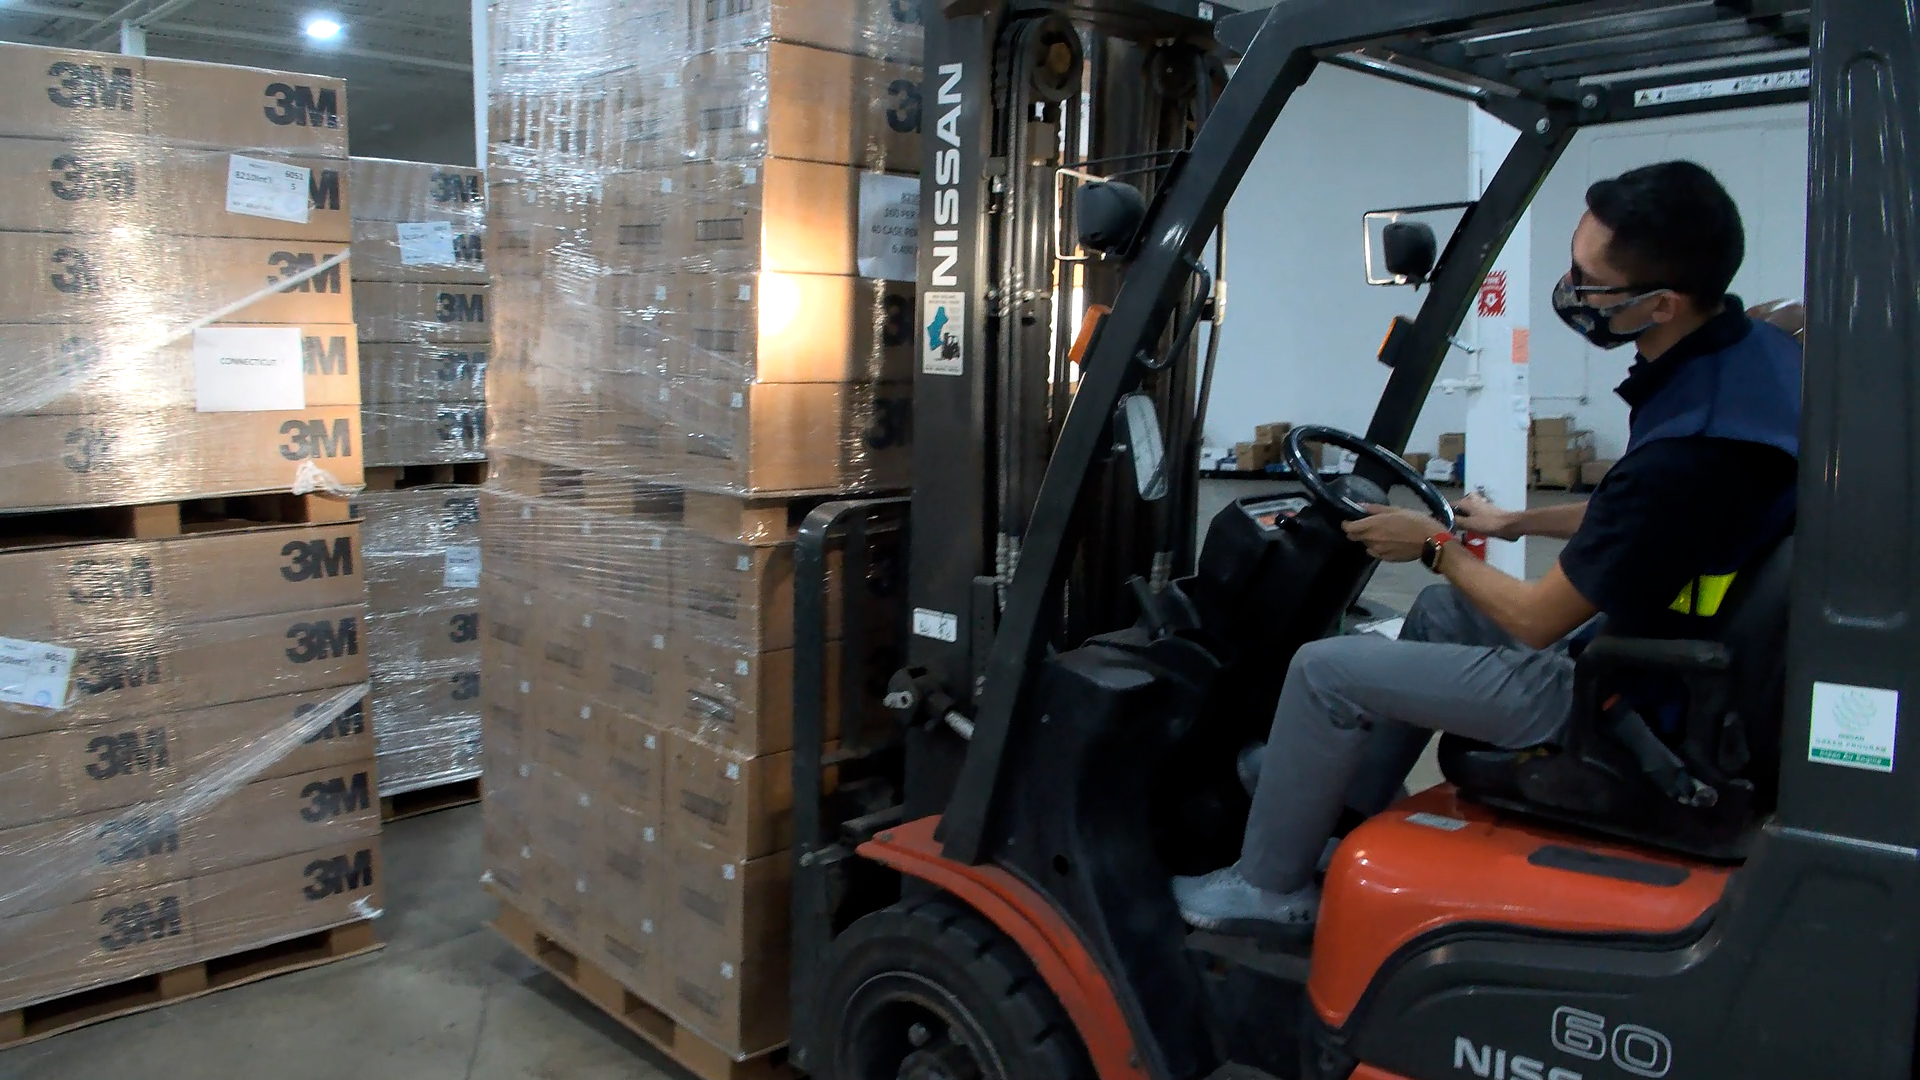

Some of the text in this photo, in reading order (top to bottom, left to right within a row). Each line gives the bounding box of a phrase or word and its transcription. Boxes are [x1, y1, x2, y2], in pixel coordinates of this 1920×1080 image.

[48, 62, 133, 111] 3M
[264, 83, 337, 128] 3M
[886, 79, 922, 133] 3
[308, 168, 340, 210] M
[430, 172, 478, 202] 3M
[932, 62, 963, 287] NISSAN
[267, 251, 341, 294] 3M
[435, 292, 485, 323] 3M
[219, 357, 277, 366] CONNECTICUT
[301, 336, 348, 375] M
[279, 418, 351, 460] 3M
[280, 536, 353, 582] 3M
[285, 617, 359, 663] 3M
[85, 727, 169, 780] 3M
[300, 772, 369, 823] 3M
[303, 849, 372, 900] 3M
[99, 896, 181, 950] 3M
[1550, 1005, 1672, 1079] 60
